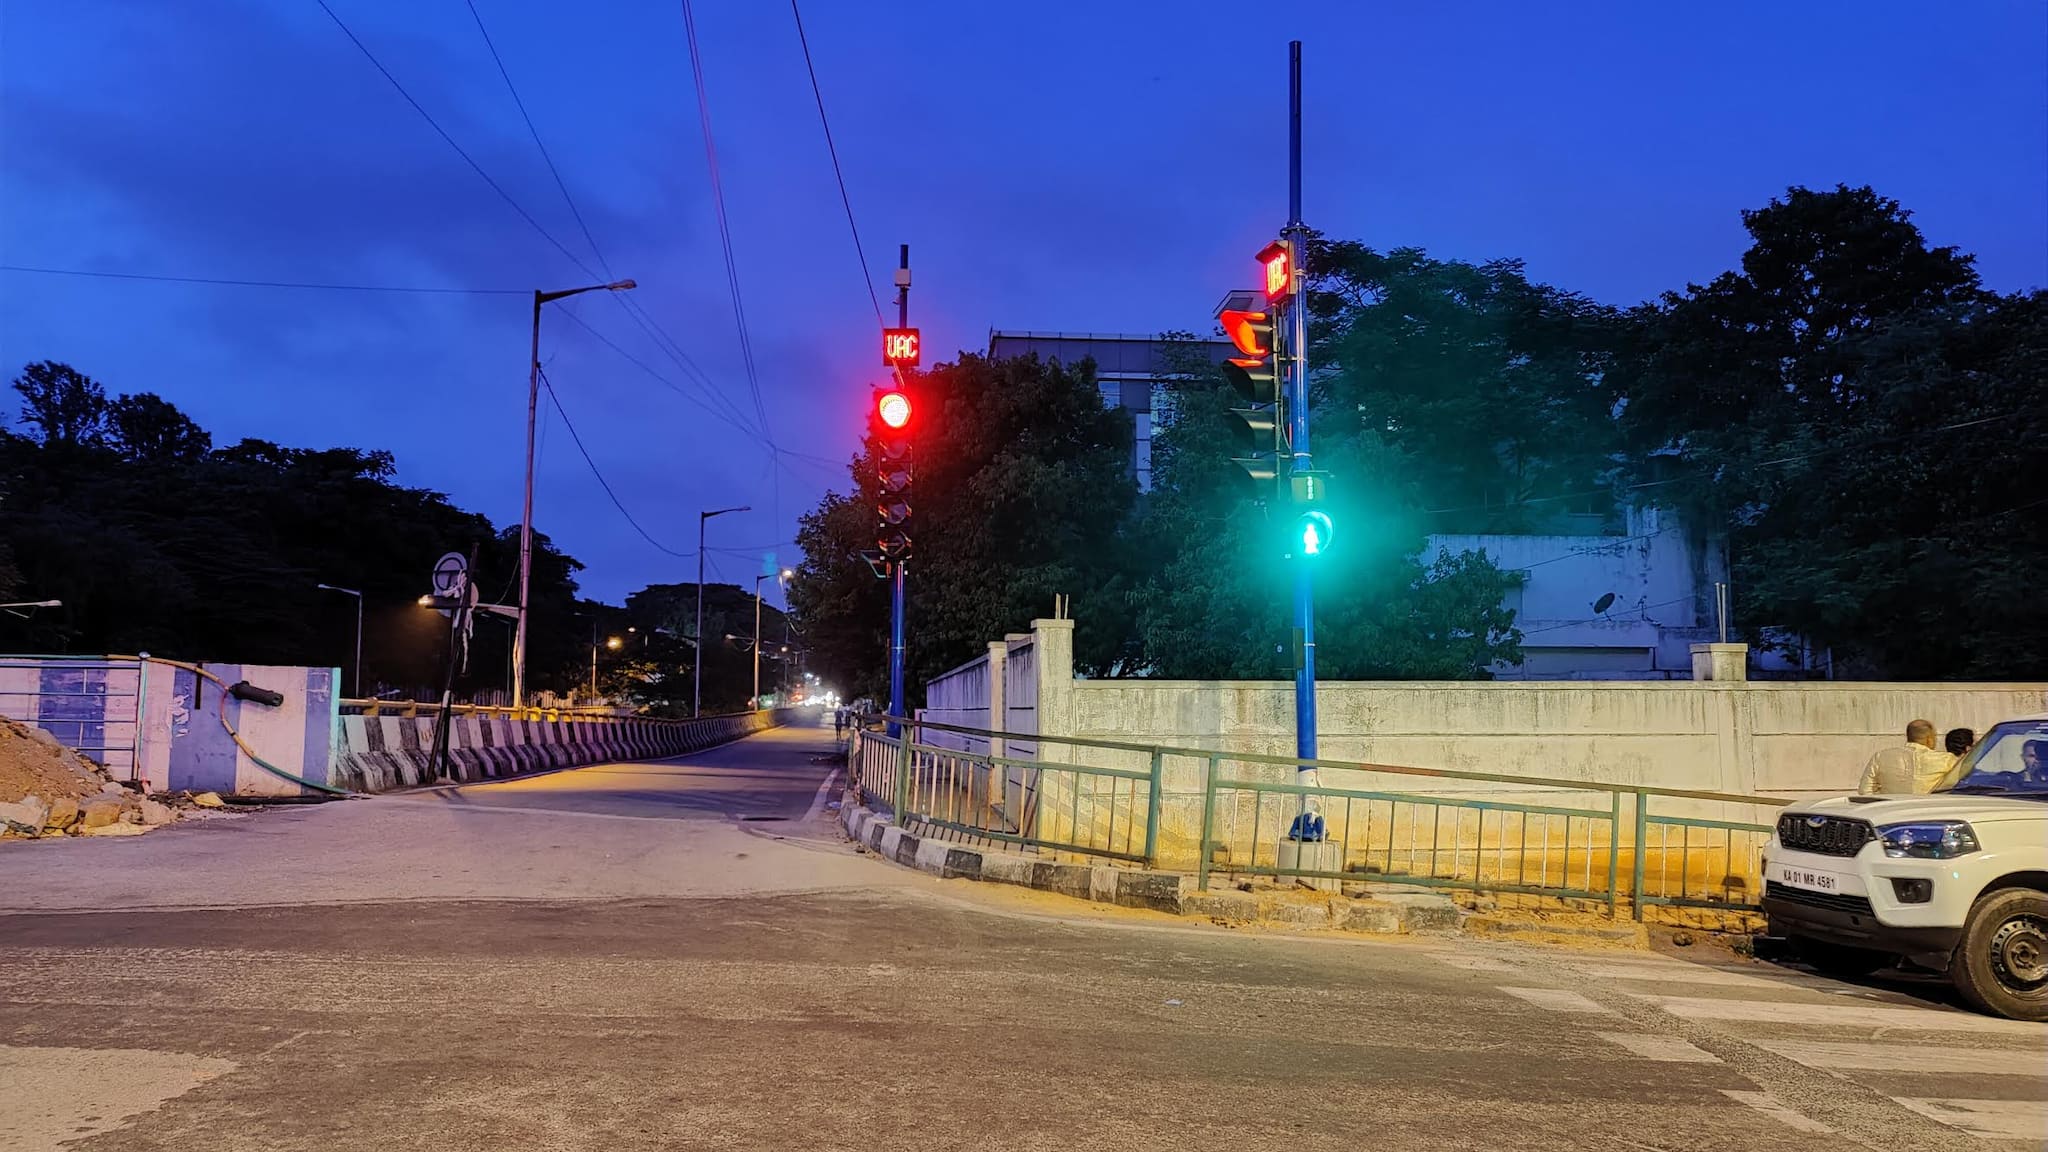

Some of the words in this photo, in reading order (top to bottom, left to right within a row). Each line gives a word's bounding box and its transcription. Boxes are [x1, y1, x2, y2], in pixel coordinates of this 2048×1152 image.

[886, 334, 918, 358] UAC
[1783, 869, 1792, 881] KA
[1793, 871, 1801, 884] 01
[1803, 873, 1815, 886] MR
[1817, 876, 1836, 889] 4581
